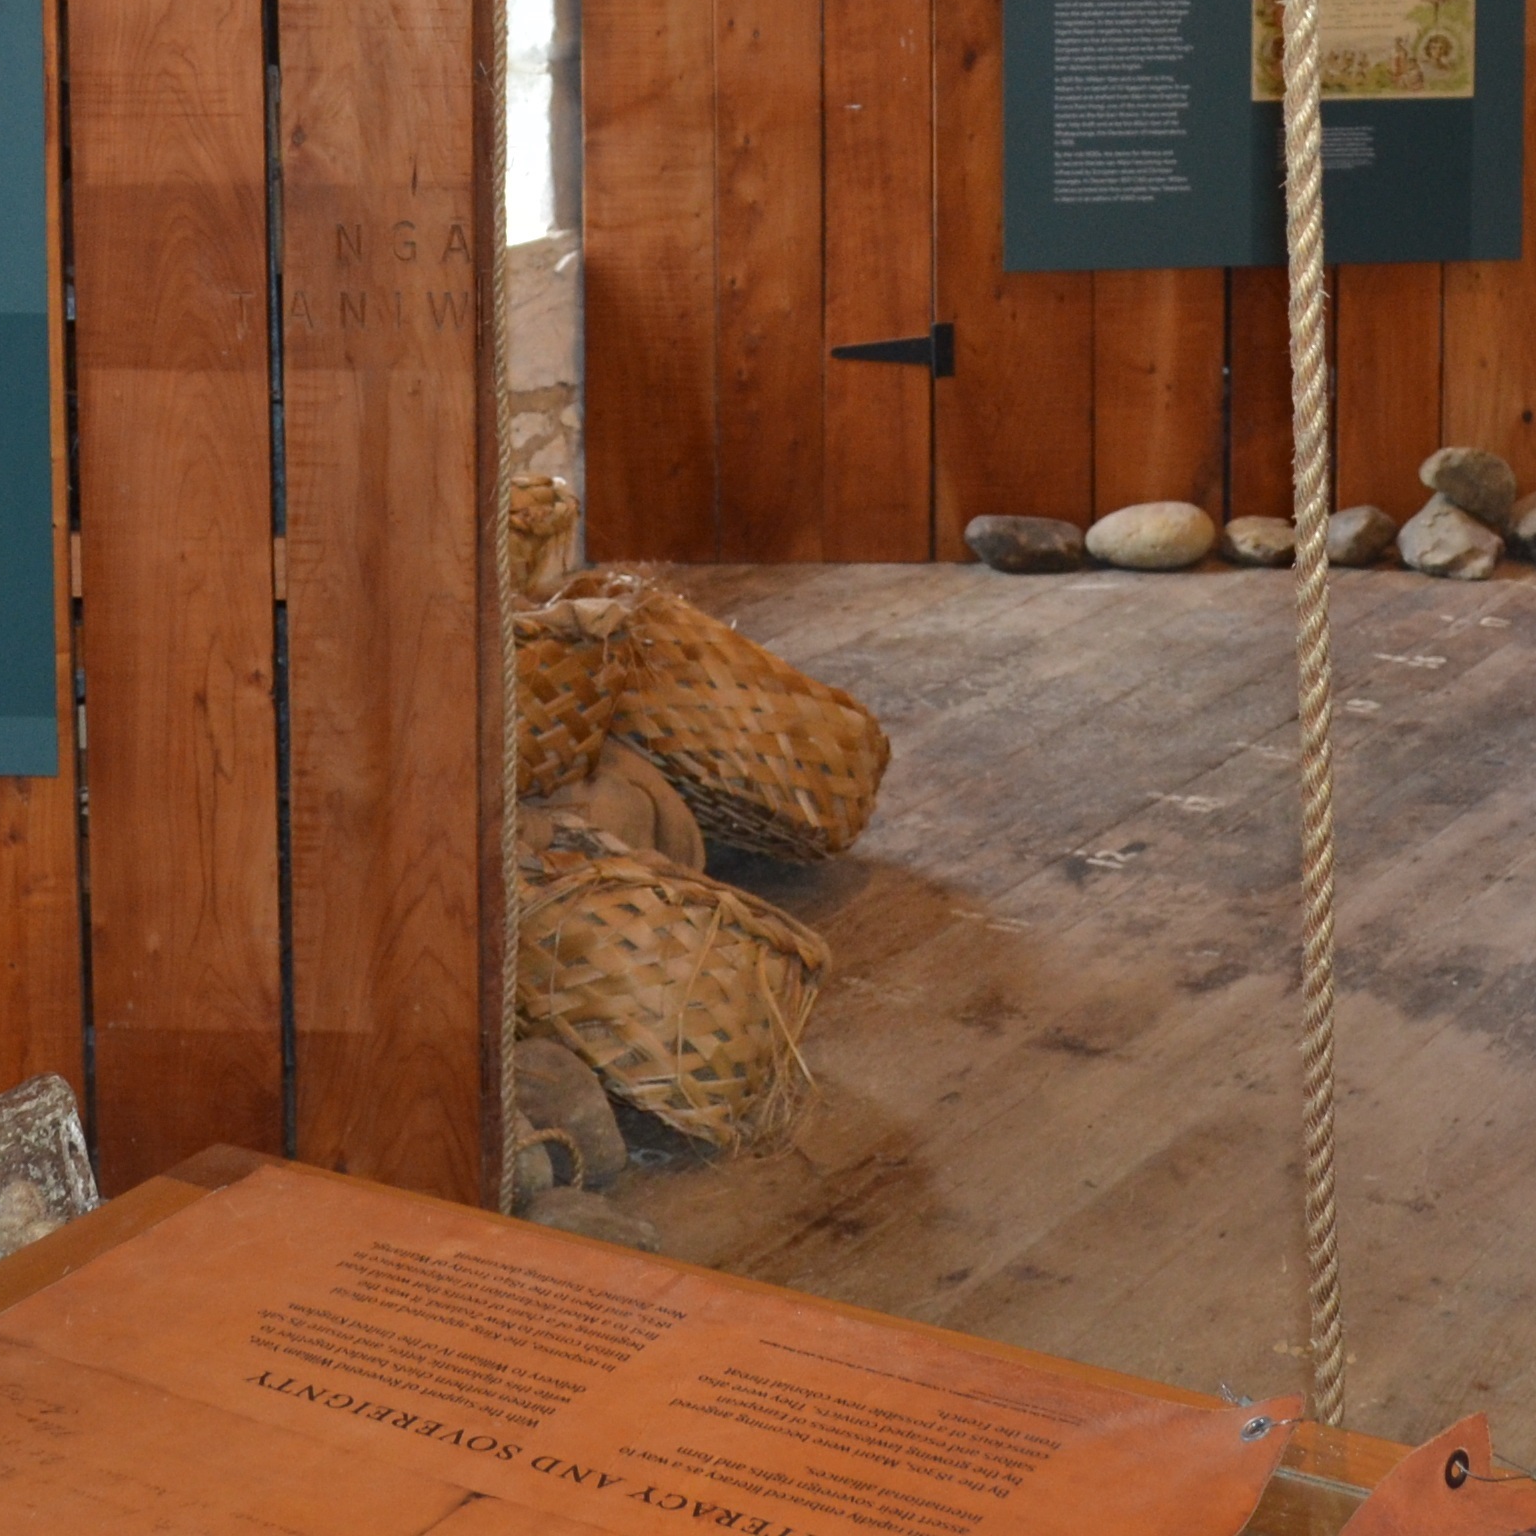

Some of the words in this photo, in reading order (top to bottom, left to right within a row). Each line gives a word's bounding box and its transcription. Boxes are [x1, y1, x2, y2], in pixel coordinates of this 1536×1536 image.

[245, 1369, 523, 1461] SOVEREIGNTY
[530, 1454, 624, 1489] AND
[625, 1485, 817, 1536] TERACY
